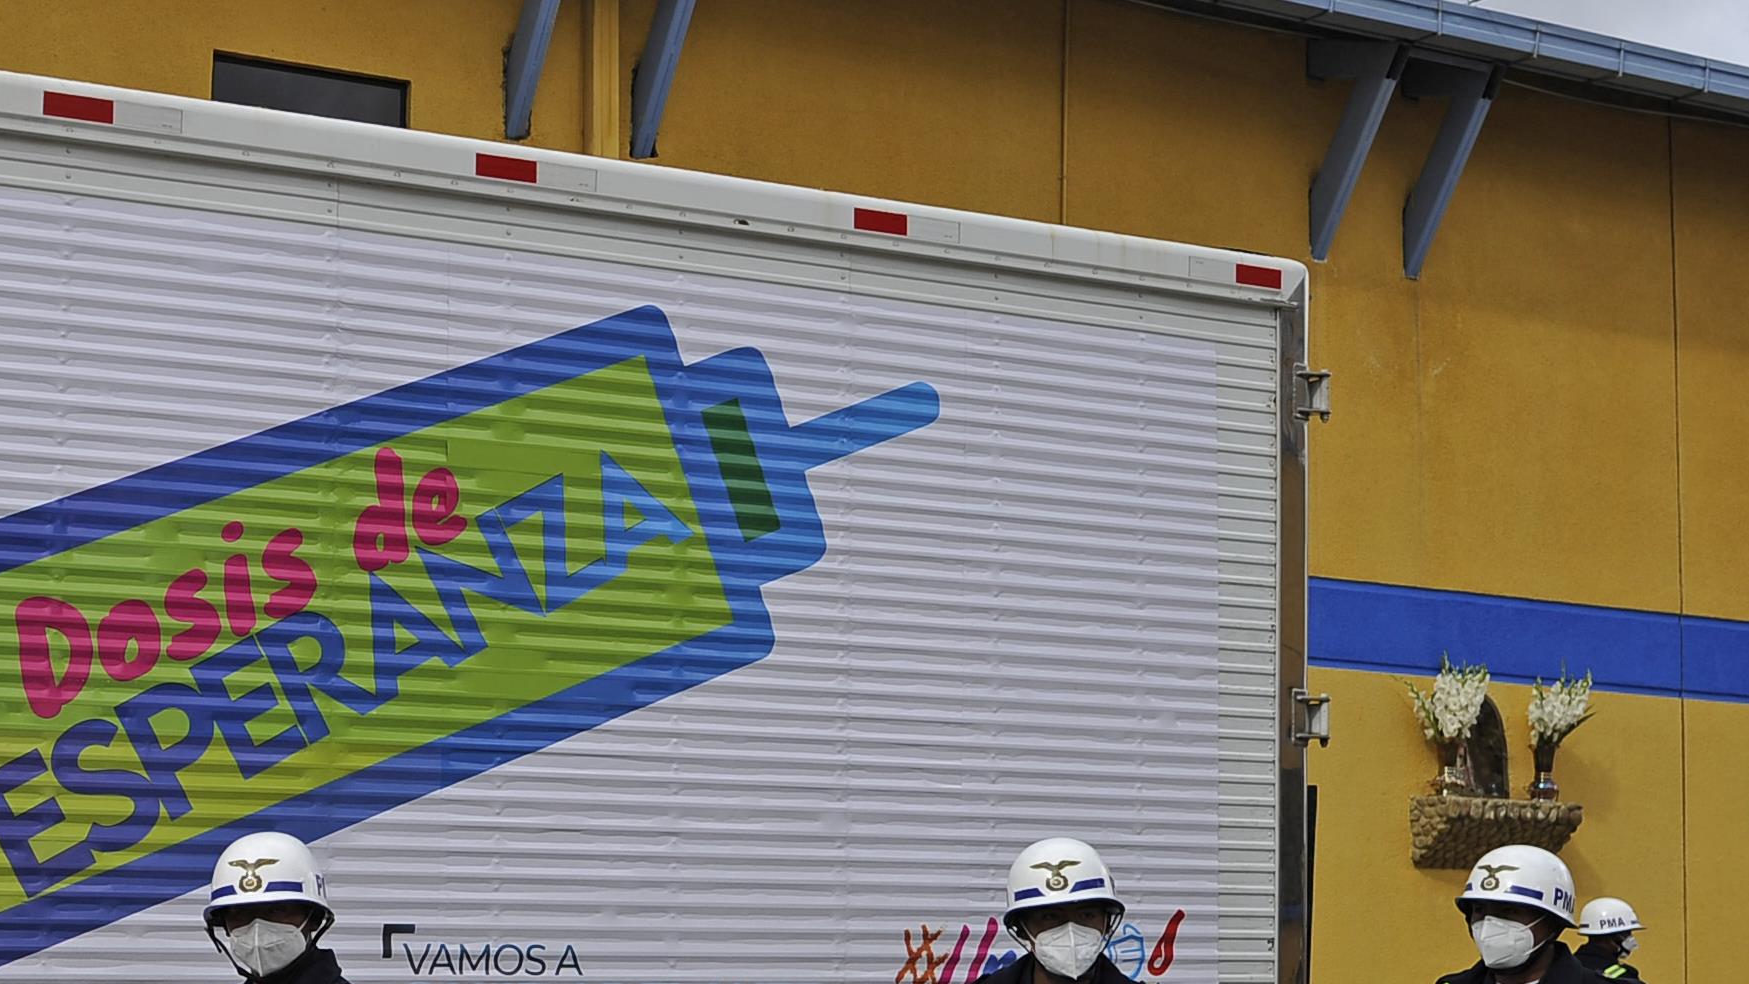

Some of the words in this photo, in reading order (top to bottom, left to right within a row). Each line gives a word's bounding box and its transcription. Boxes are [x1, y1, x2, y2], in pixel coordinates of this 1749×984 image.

[15, 521, 318, 719] Dosis
[352, 447, 468, 572] de
[1599, 917, 1626, 929] PMA
[402, 943, 547, 976] VAMOS
[554, 943, 584, 976] A
